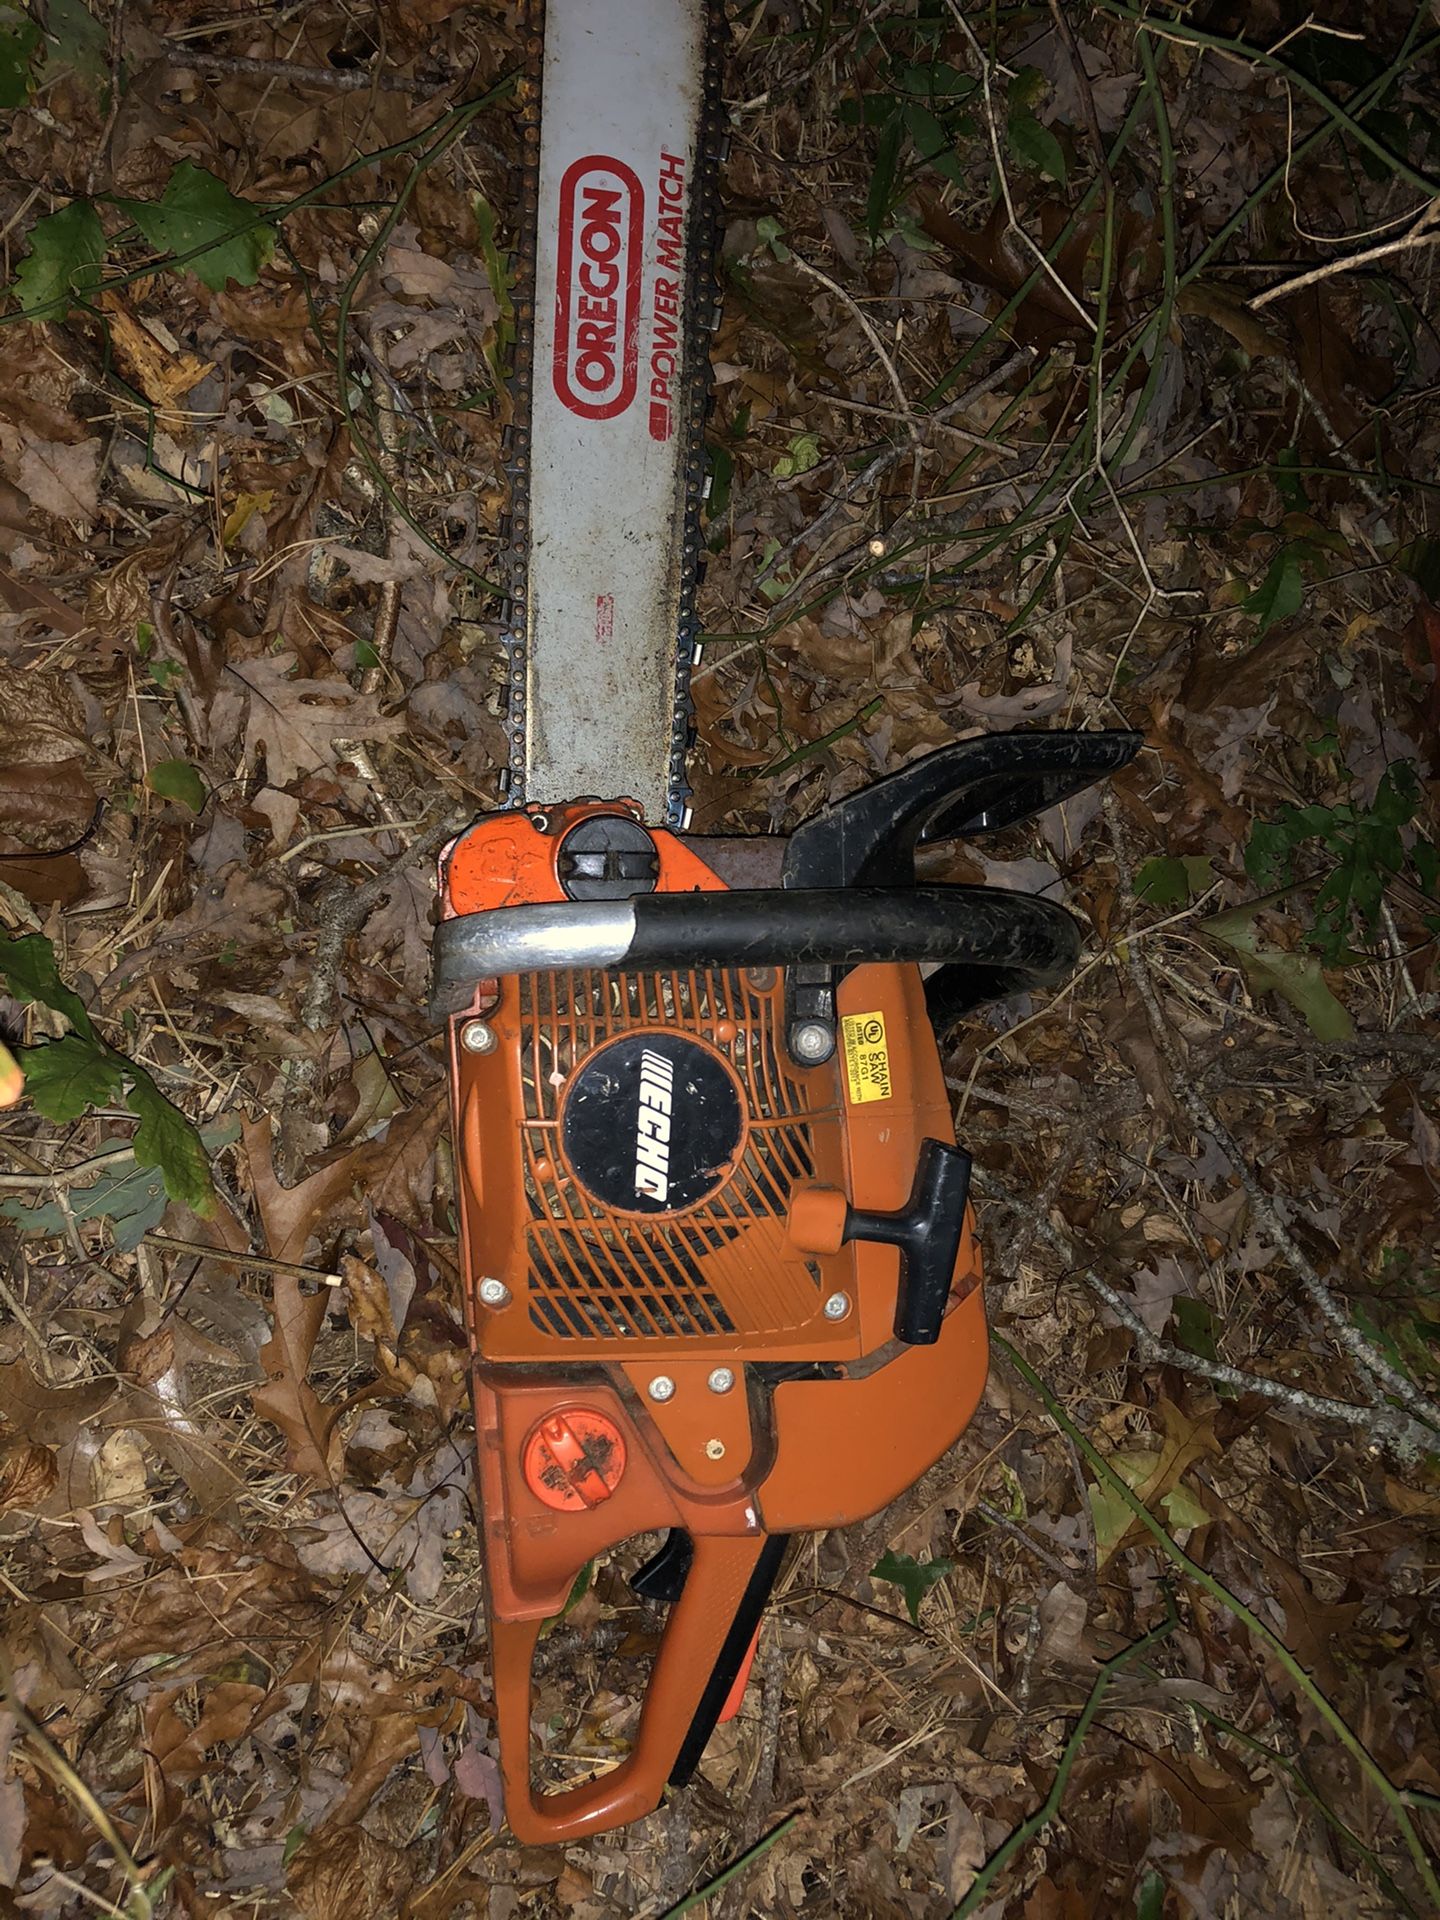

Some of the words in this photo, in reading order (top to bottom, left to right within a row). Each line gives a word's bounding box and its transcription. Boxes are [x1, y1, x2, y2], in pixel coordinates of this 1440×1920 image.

[656, 152, 686, 273] MATCH
[574, 187, 623, 393] OREGON
[650, 277, 680, 401] POWER
[860, 1054, 868, 1080] 87G1
[868, 1025, 879, 1038] UL
[869, 1053, 880, 1085] SAW
[877, 1051, 890, 1096] CHAIN
[634, 1080, 673, 1202] ECHO
